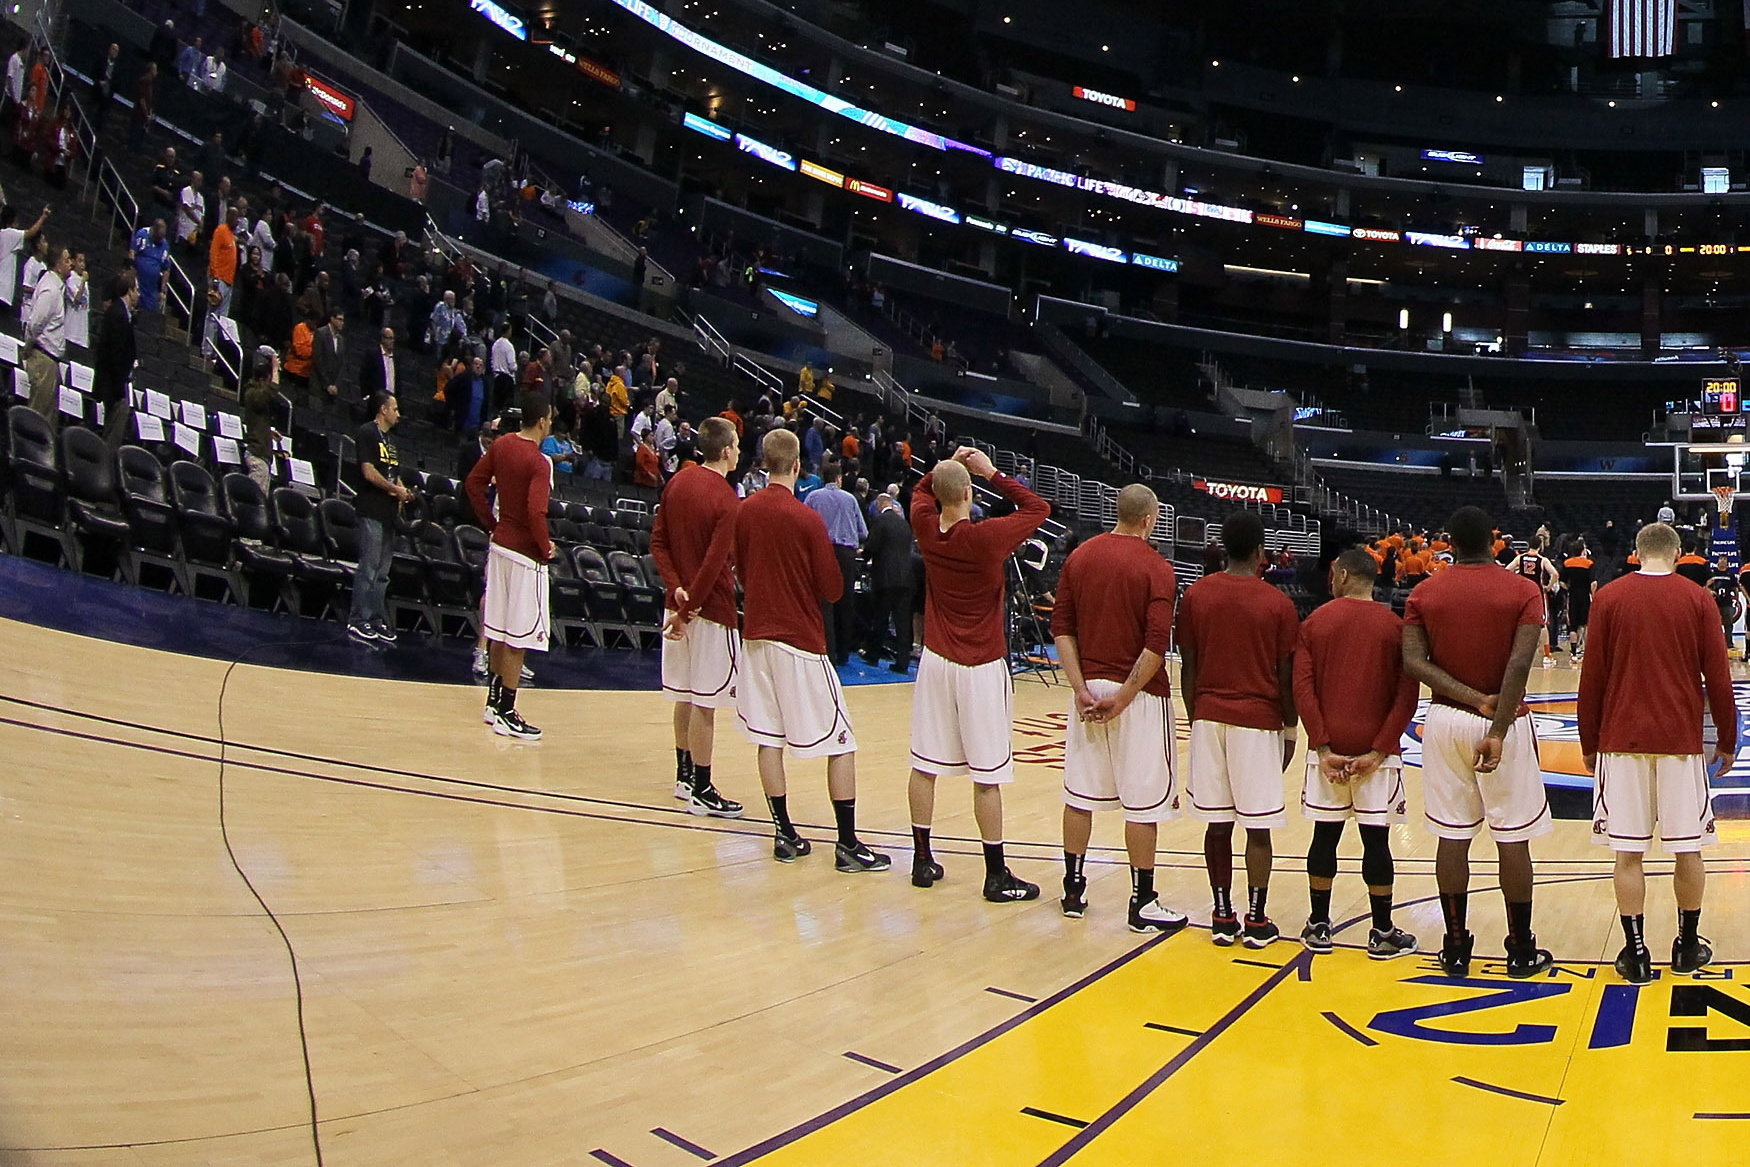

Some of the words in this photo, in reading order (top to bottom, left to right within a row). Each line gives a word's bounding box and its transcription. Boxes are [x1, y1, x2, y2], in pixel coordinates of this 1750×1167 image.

[670, 22, 753, 71] TOURNAMENT
[1081, 87, 1126, 109] TOYOTA
[1026, 163, 1077, 188] PACIFIC
[1076, 176, 1105, 195] LIFE
[1365, 229, 1400, 242] TOYOTA
[1536, 243, 1571, 252] DELTA
[1577, 243, 1619, 255] STAPLES
[1143, 256, 1178, 272] DELTA
[1705, 382, 1737, 394] 20:00
[1205, 481, 1269, 502] TOYOTA
